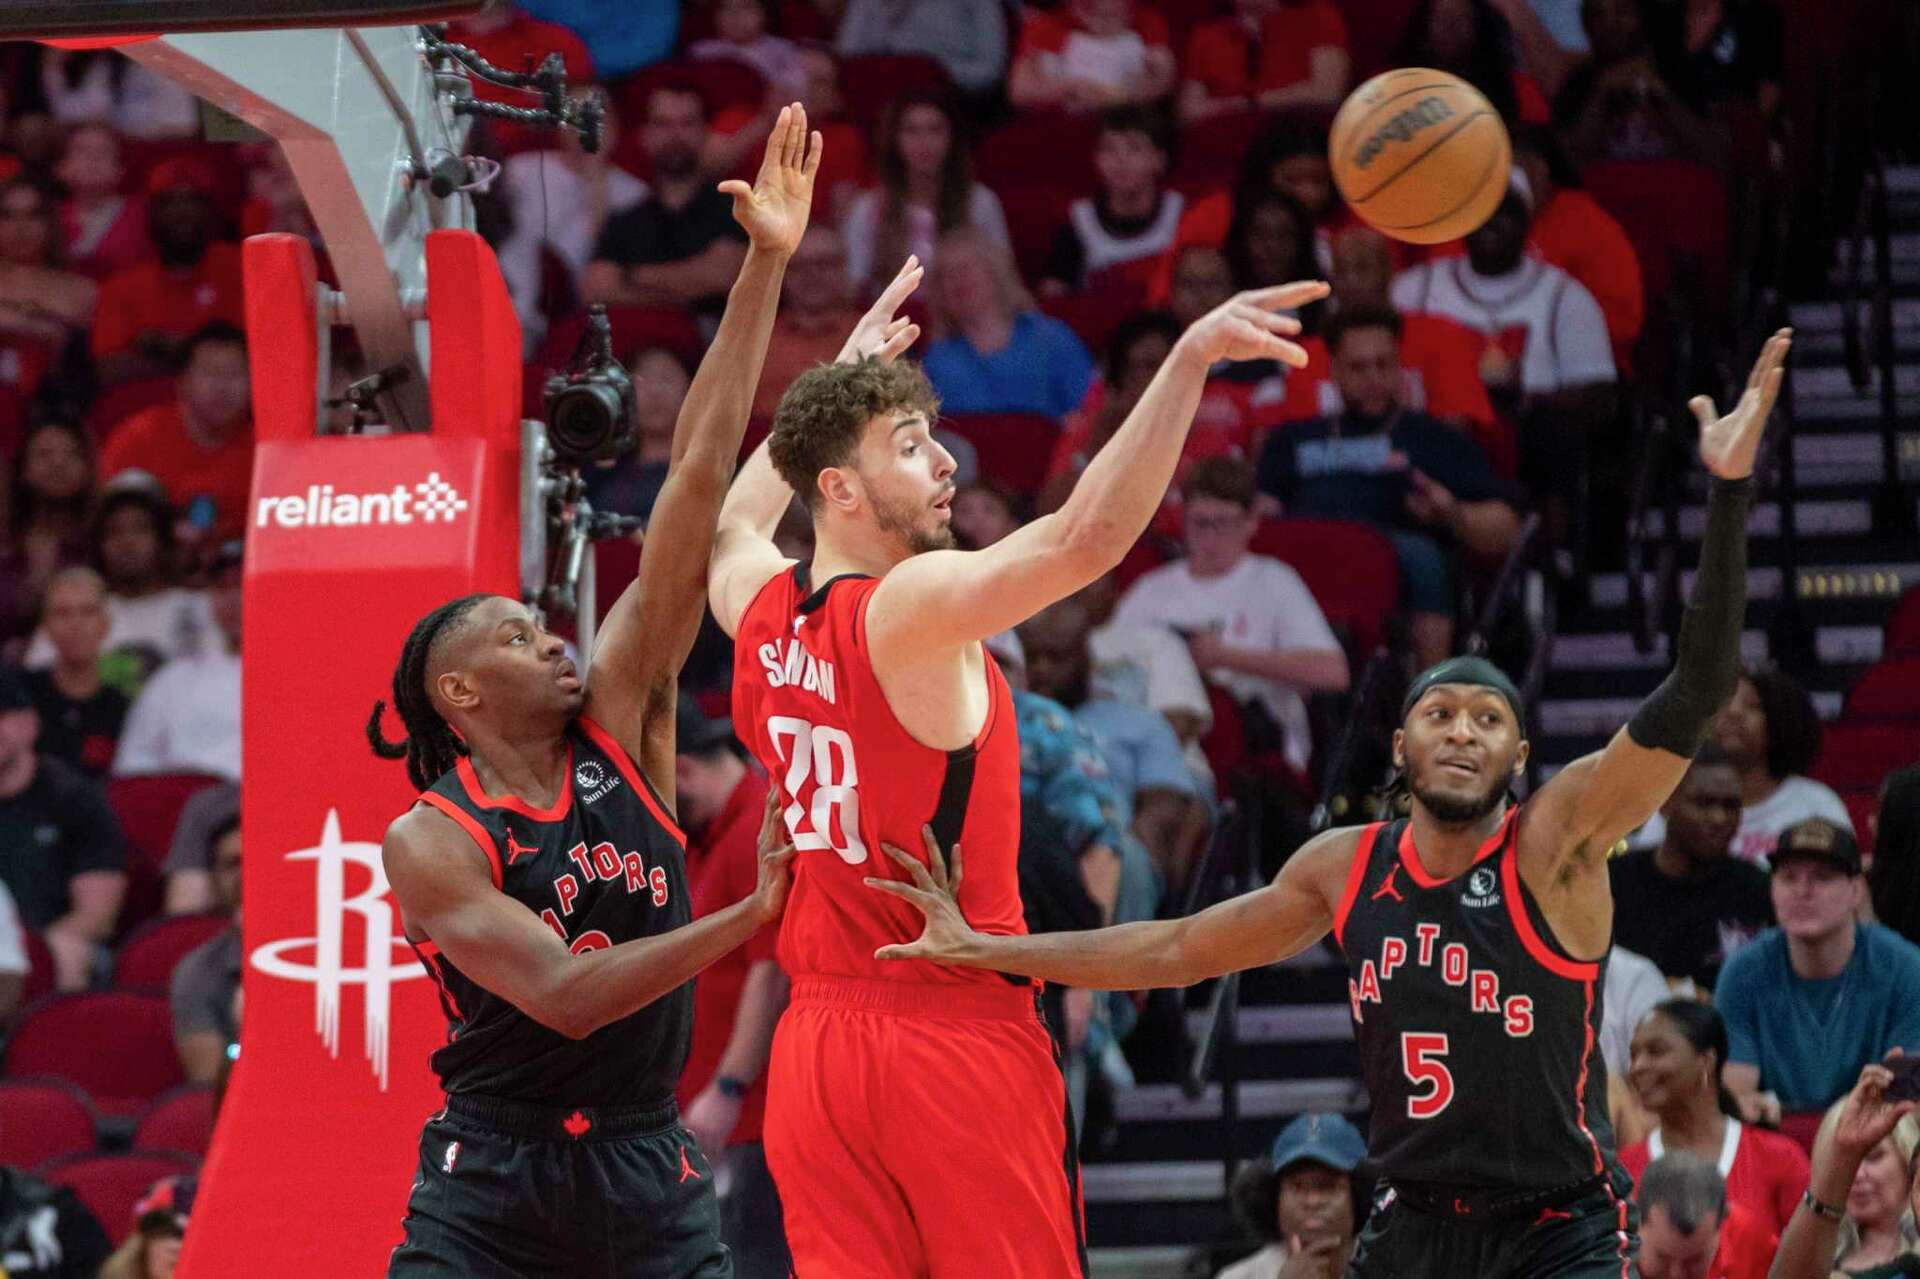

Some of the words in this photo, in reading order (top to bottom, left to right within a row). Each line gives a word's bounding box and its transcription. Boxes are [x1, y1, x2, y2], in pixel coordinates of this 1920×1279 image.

[256, 484, 413, 527] reliant
[583, 790, 603, 805] Sun
[600, 775, 621, 793] Life
[767, 715, 868, 865] 28
[541, 840, 669, 942] PTORS
[1401, 1031, 1454, 1119] 5
